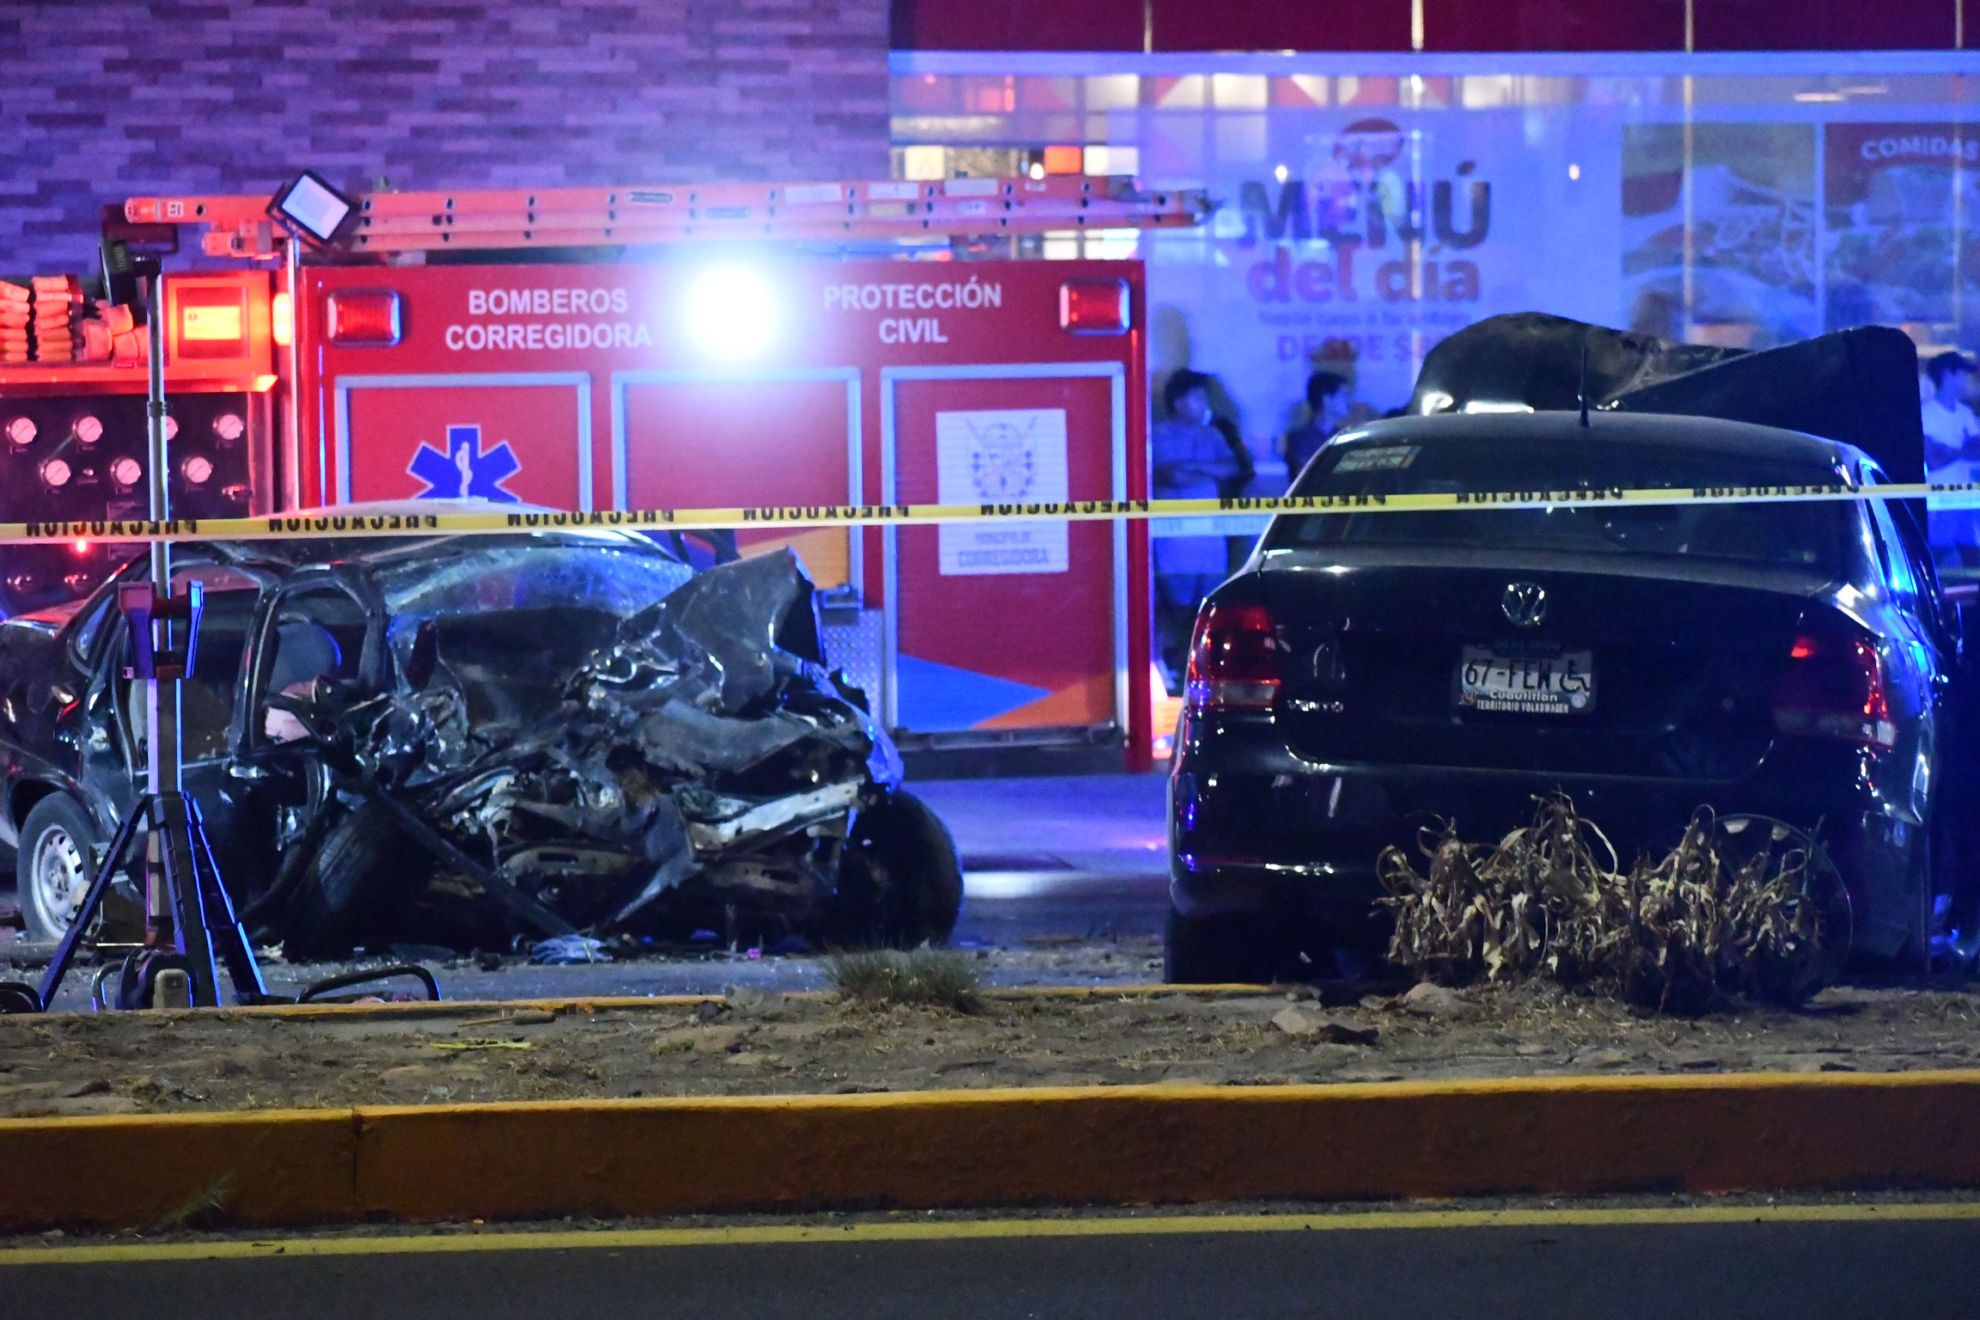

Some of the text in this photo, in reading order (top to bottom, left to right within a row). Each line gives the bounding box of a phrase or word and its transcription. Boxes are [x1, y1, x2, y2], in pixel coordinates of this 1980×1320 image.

[1861, 136, 1977, 161] COMIDAS
[1239, 160, 1491, 249] MENÚ
[1247, 244, 1480, 301] del día
[468, 289, 628, 314] BOMBEROS
[824, 274, 1001, 310] PROTECCIÓN
[445, 323, 653, 350] CORREGIDORA
[879, 318, 948, 344] CIVIL
[1477, 700, 1569, 714] TERRITORIO VOLKSWAGEN
